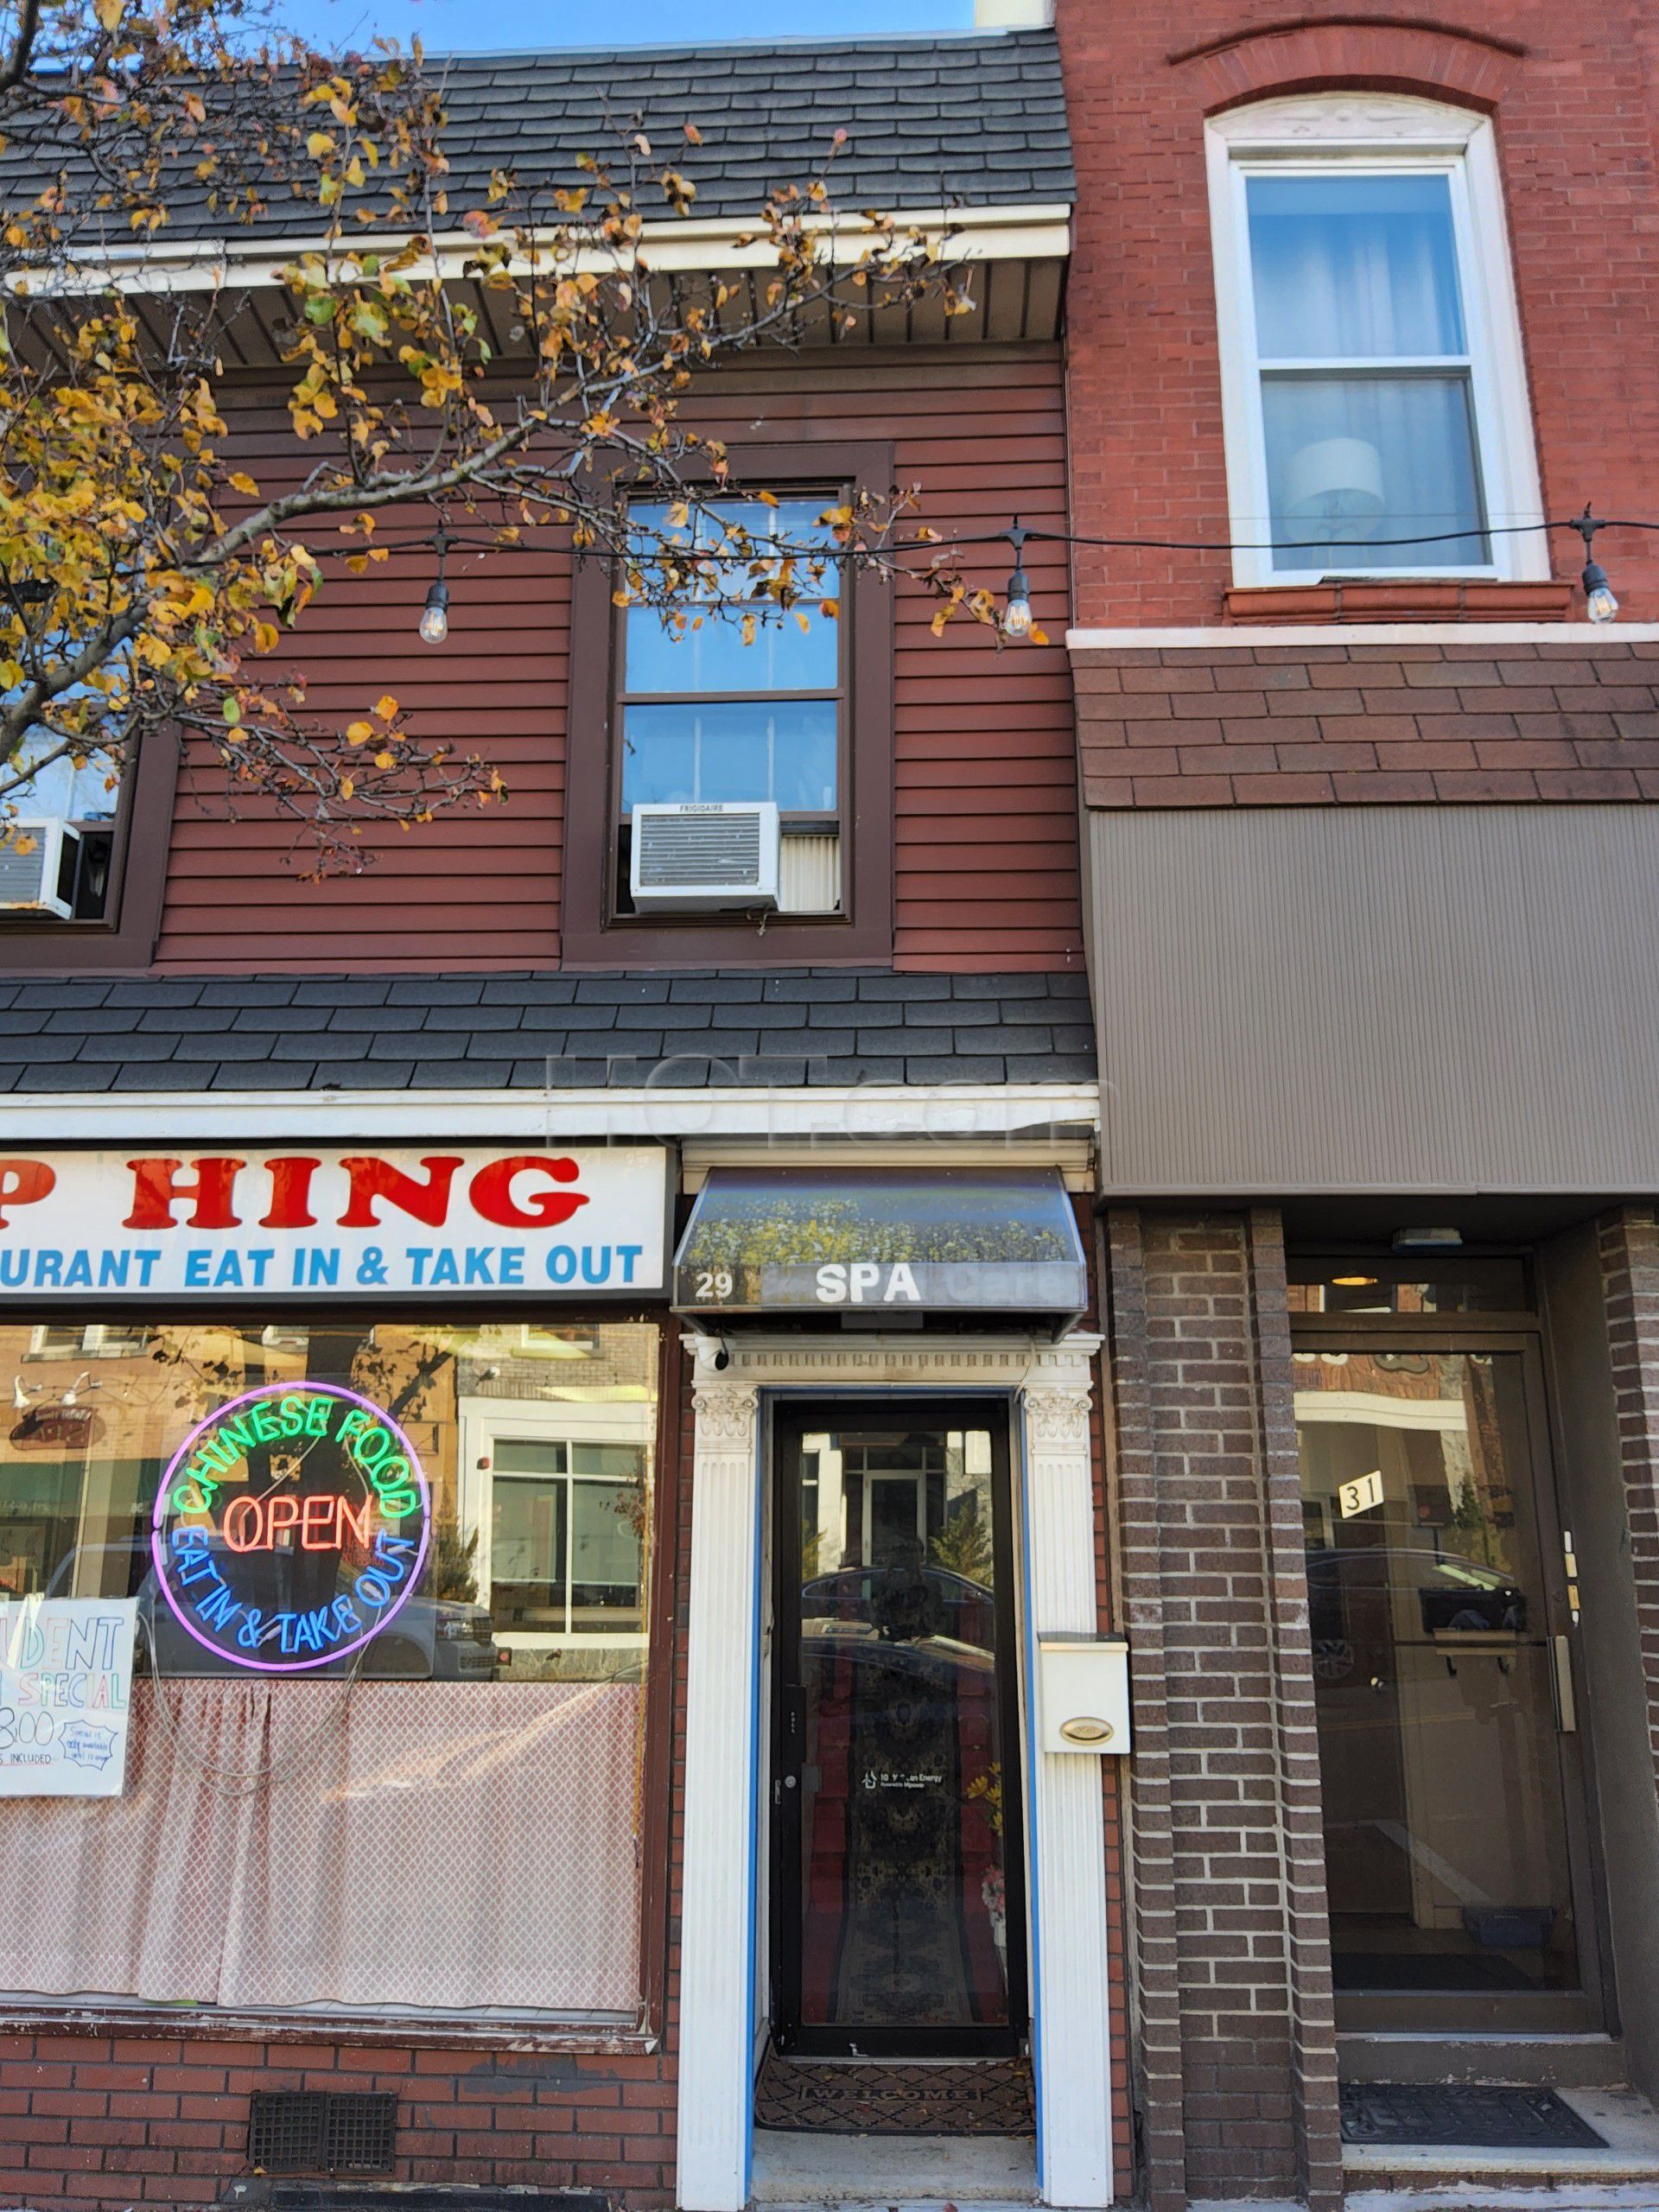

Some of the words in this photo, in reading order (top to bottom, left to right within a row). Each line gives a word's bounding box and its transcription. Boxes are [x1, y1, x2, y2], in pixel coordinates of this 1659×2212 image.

[122, 1156, 590, 1230] HING
[0, 1249, 162, 1287] URANT
[184, 1249, 275, 1287] EAT
[292, 1248, 340, 1286] IN
[356, 1246, 389, 1285] &
[406, 1246, 525, 1285] TAKE
[545, 1244, 643, 1284] OUT
[695, 1272, 733, 1298] 29
[816, 1262, 921, 1302] SPA
[173, 1395, 334, 1514] CHINESE
[335, 1409, 416, 1518] FOOD
[1345, 1477, 1375, 1511] 31
[223, 1494, 373, 1552] OPEN
[171, 1525, 219, 1586] EAT
[195, 1583, 243, 1632] IN
[238, 1608, 264, 1649] &
[275, 1593, 363, 1654] TAKE
[355, 1528, 415, 1608] OUT
[18, 1672, 127, 1709] SPECIAL
[10, 1752, 52, 1764] INCLUDED
[812, 2088, 970, 2101] WELCOME
